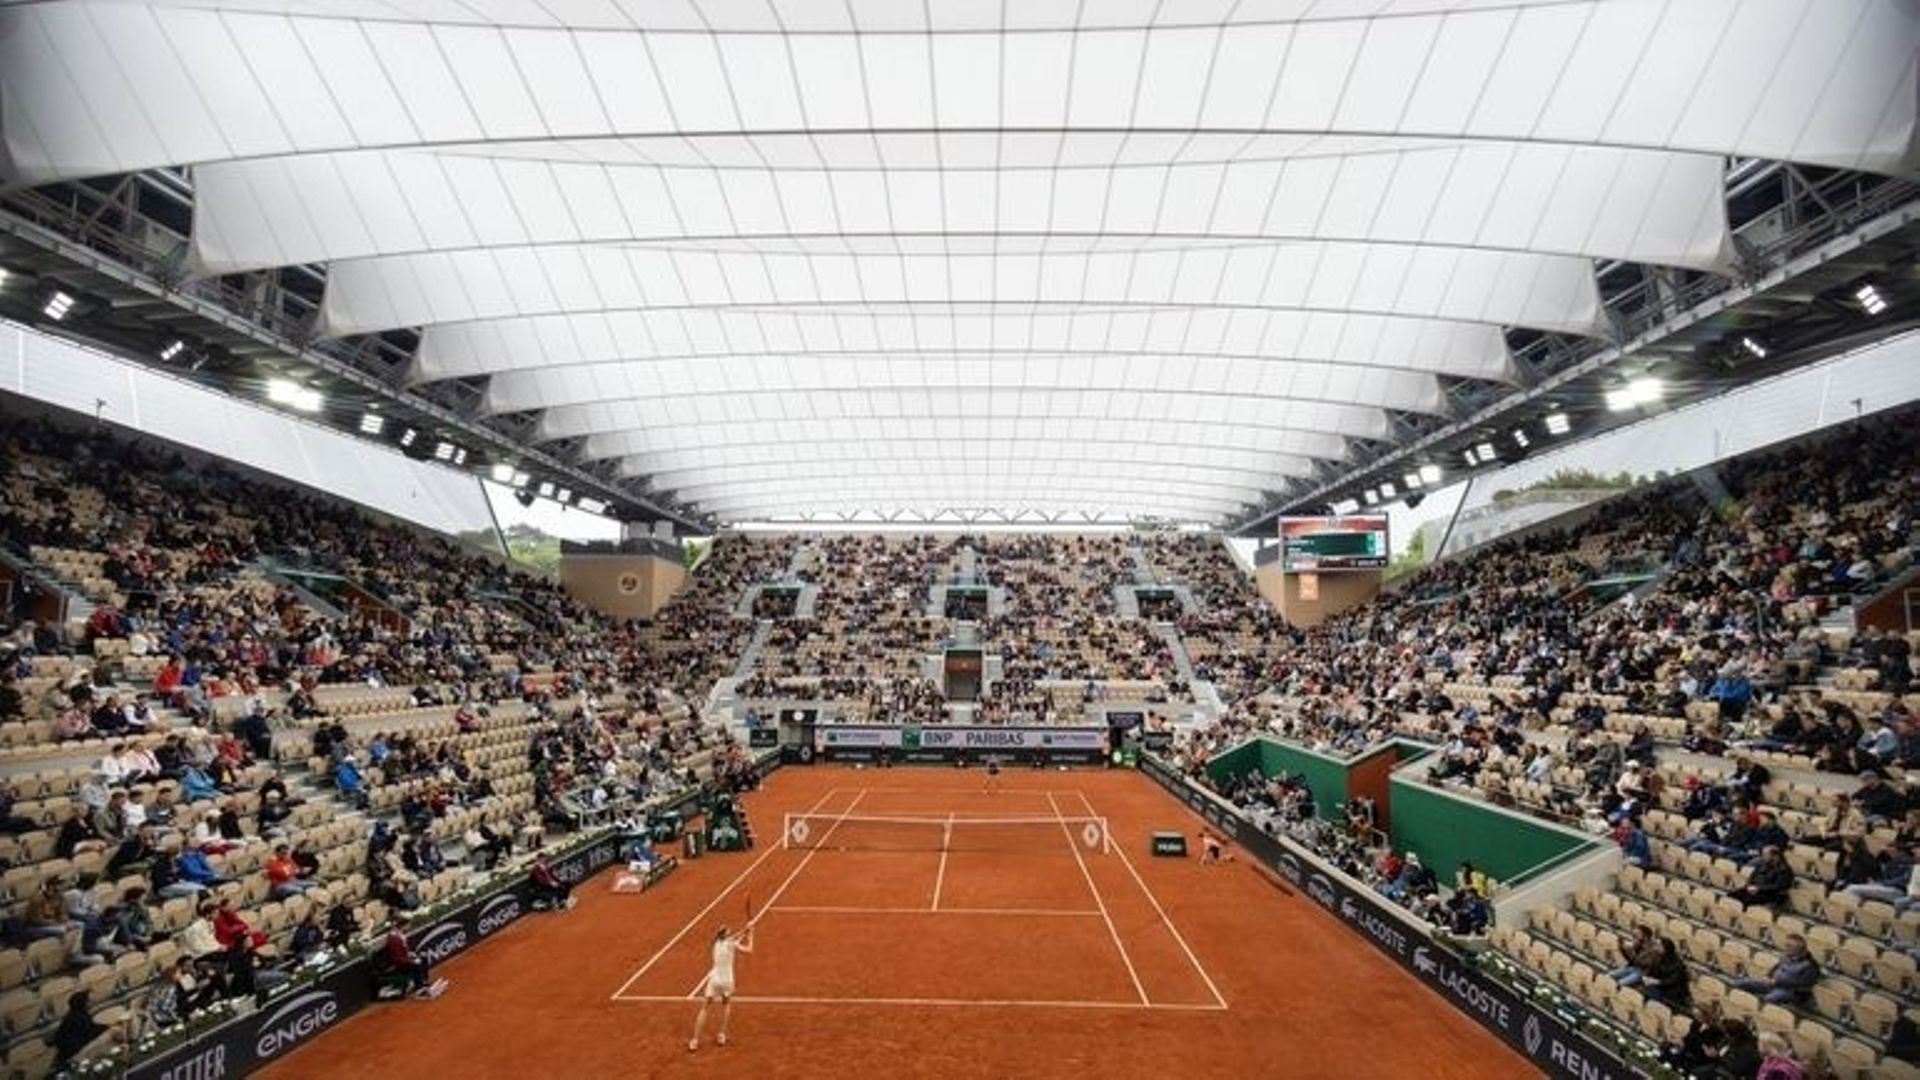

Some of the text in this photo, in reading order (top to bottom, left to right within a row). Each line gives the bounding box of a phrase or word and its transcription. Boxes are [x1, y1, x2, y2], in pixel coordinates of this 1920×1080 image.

[924, 732, 1025, 746] BNP PARIBAS
[1358, 911, 1407, 955] LACOSTE
[1440, 963, 1511, 1029] LACOSTE
[160, 1043, 226, 1080] TTER
[1551, 1040, 1613, 1080] REN
